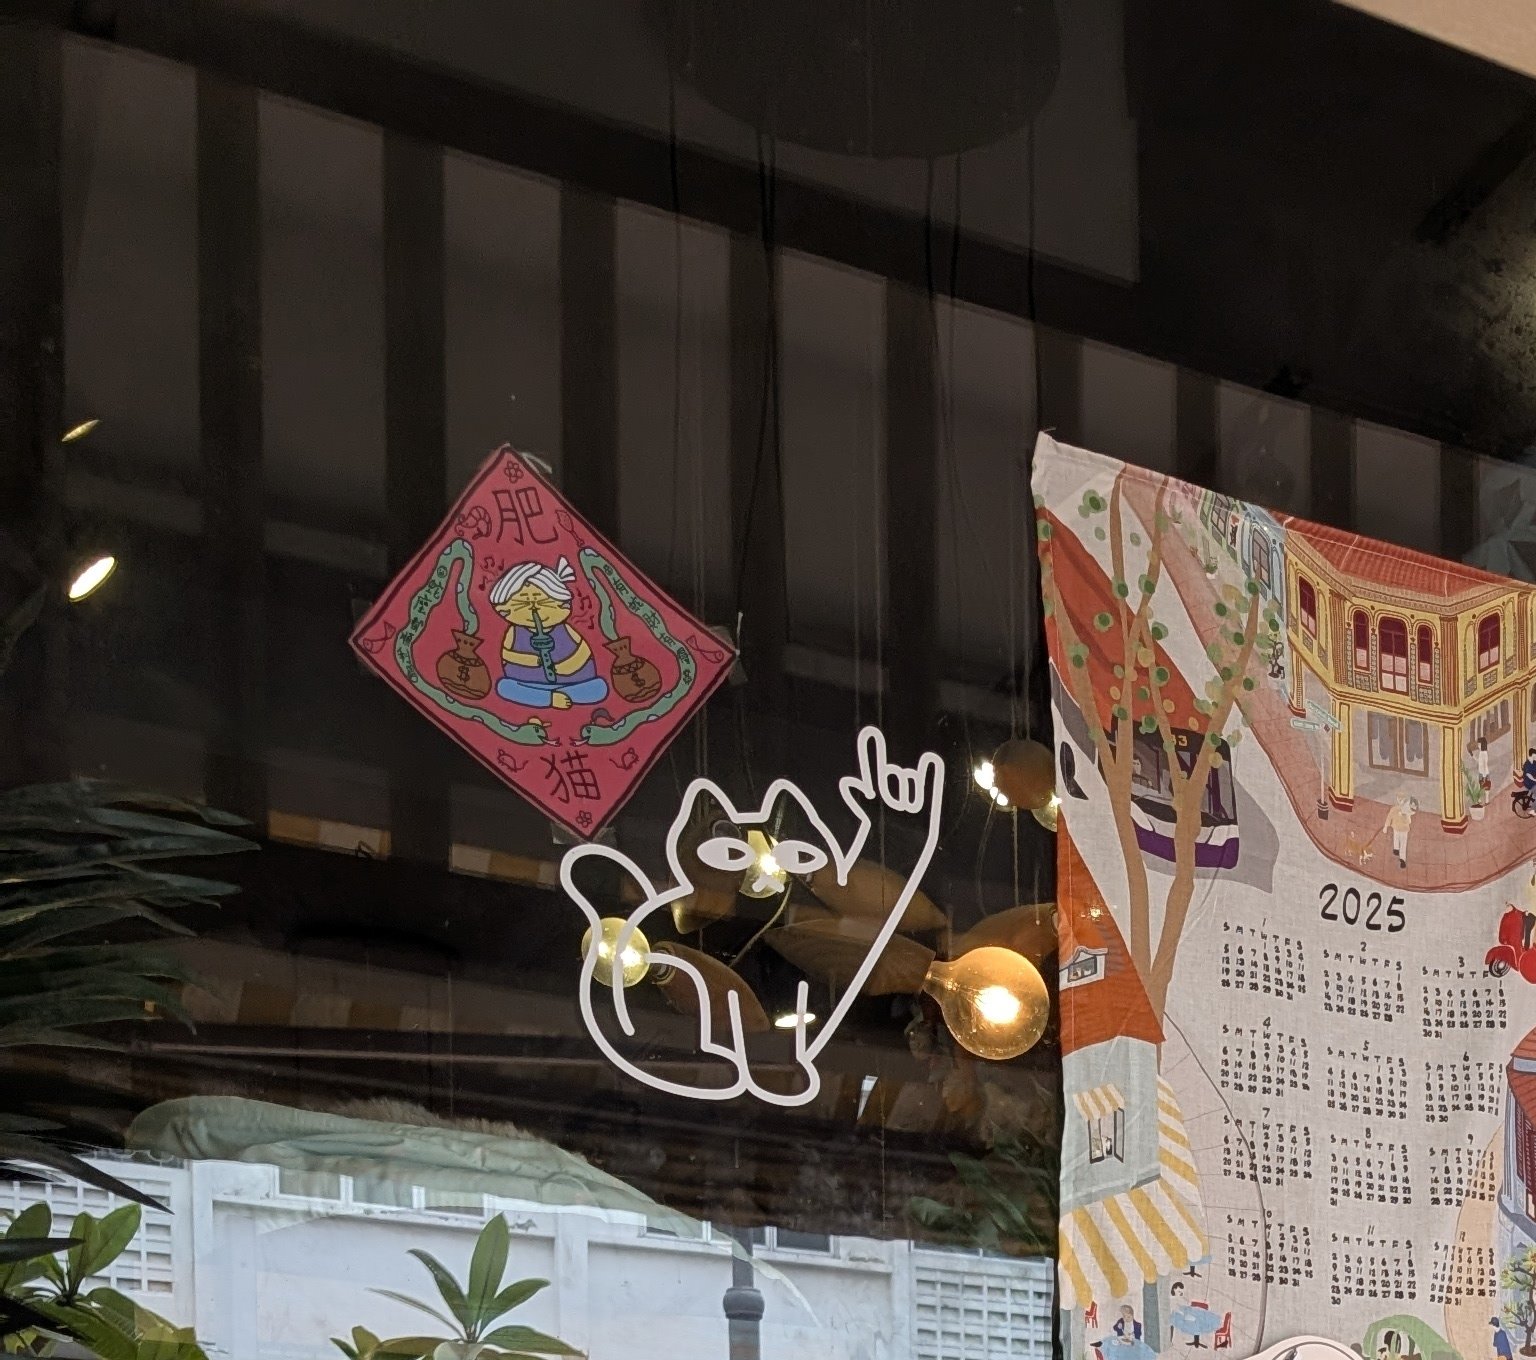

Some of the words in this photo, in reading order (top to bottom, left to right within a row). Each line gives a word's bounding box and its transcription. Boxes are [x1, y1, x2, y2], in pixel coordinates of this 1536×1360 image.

[491, 485, 558, 546] 肥
[540, 749, 601, 804] 猫
[1319, 883, 1406, 933] 2025
